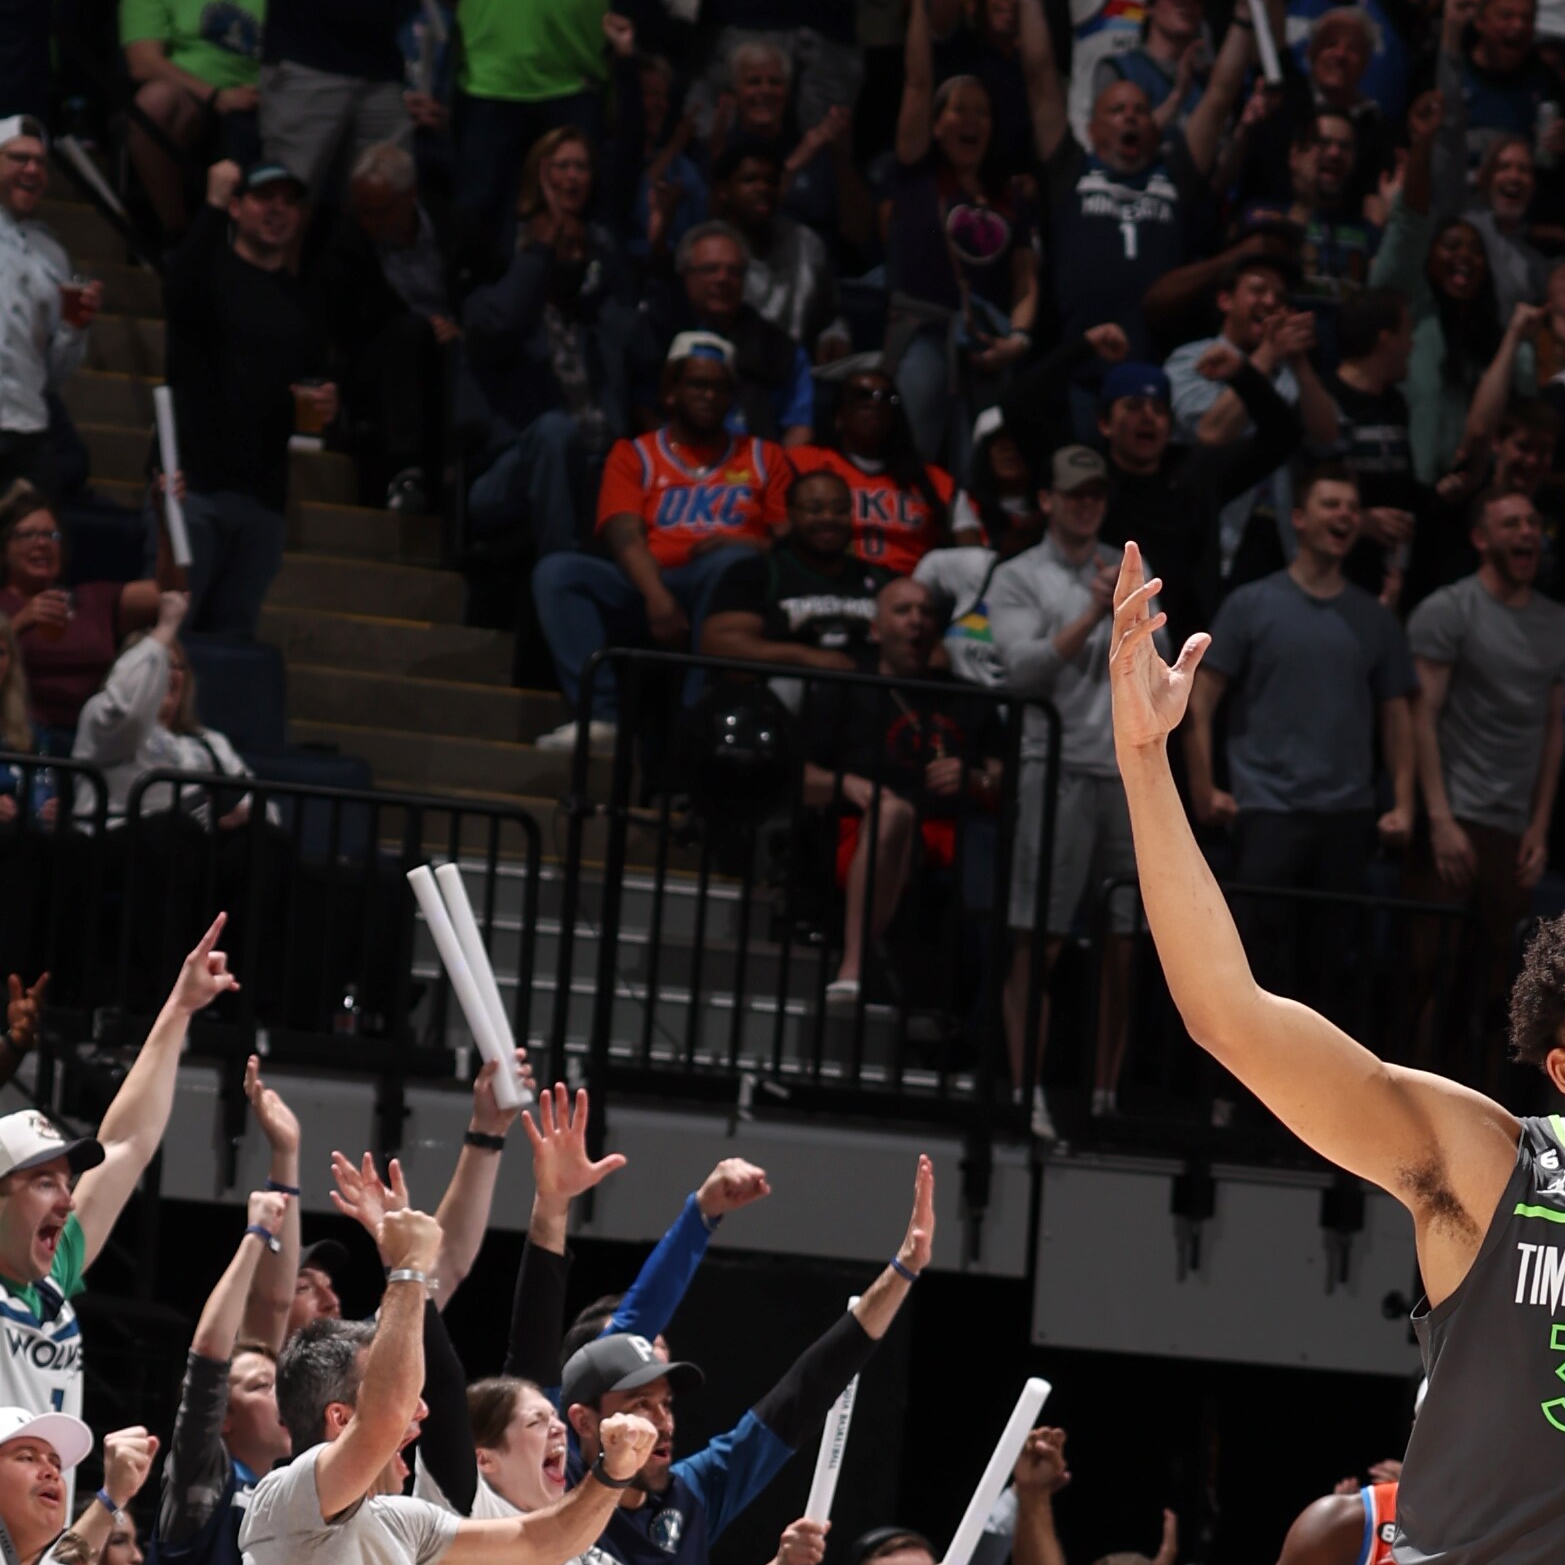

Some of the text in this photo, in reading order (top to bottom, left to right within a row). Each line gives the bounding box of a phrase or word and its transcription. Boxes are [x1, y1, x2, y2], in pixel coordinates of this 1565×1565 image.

[655, 485, 755, 531] OKC
[860, 488, 928, 532] KC
[1540, 1148, 1559, 1169] 6
[5, 1327, 86, 1372] WOLVE
